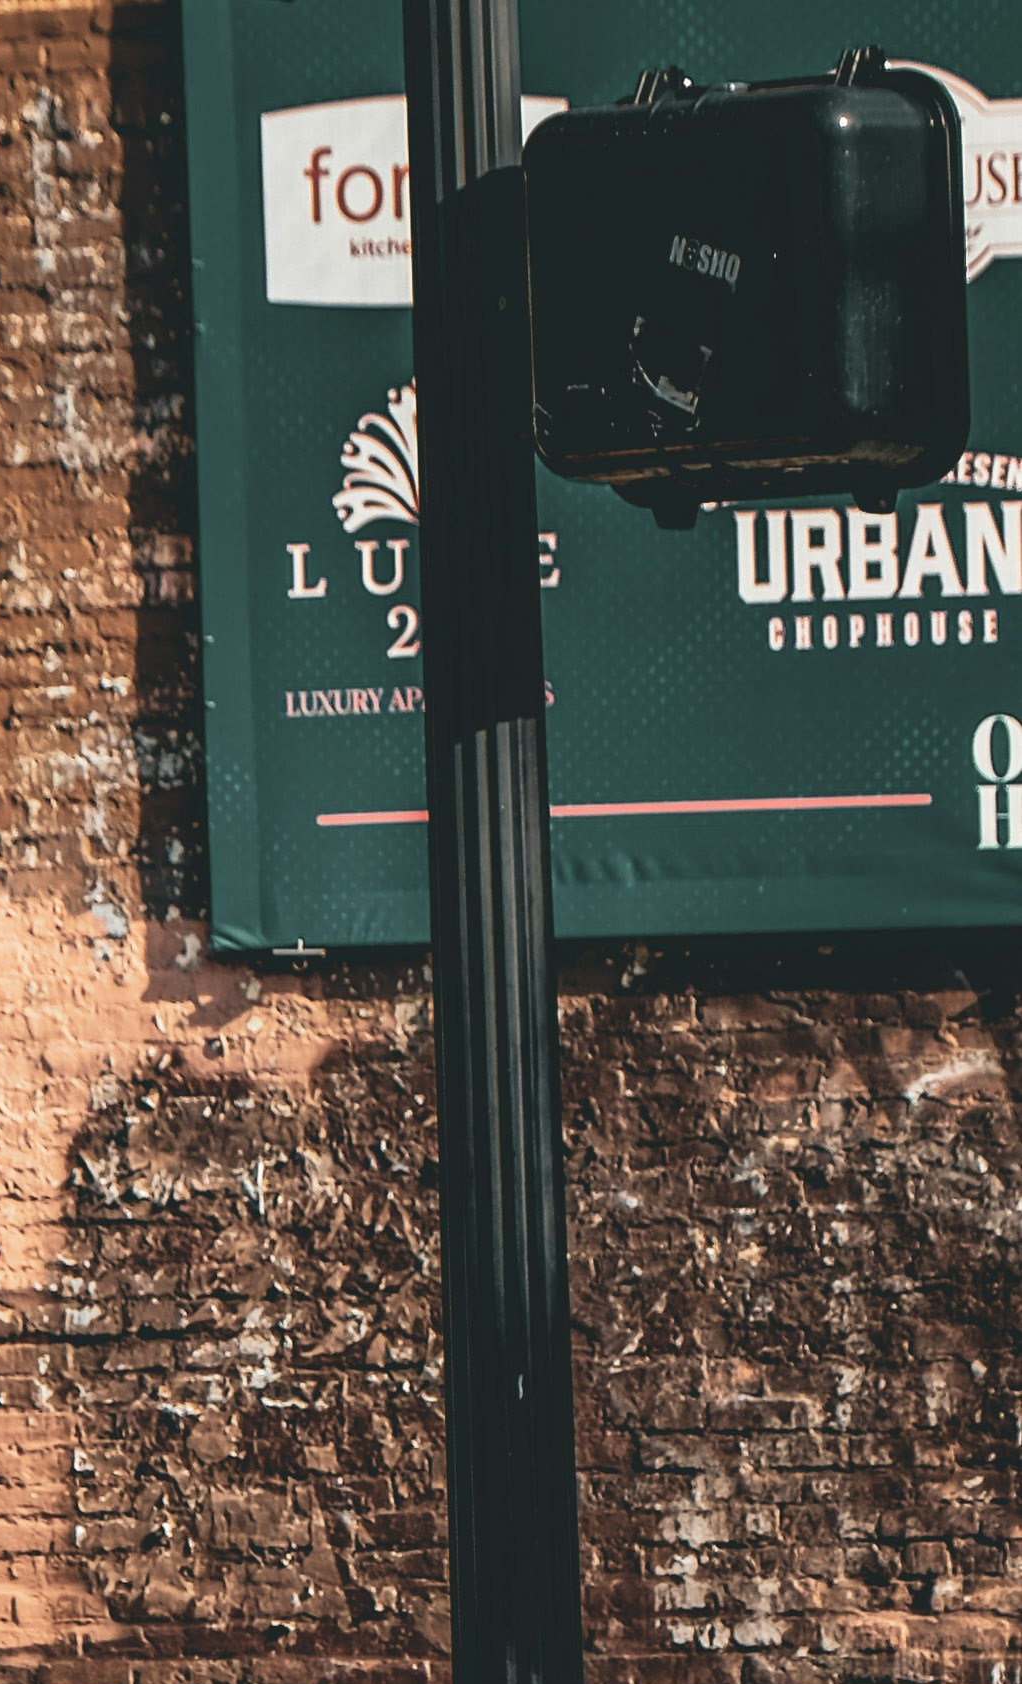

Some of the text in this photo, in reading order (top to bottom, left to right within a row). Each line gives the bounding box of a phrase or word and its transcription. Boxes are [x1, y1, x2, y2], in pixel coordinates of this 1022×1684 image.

[940, 451, 1022, 492] ESEN
[286, 531, 561, 599] LUE
[733, 500, 1022, 604] URBAN
[768, 608, 999, 651] CHOPHOUSE
[285, 687, 383, 717] LUXURY
